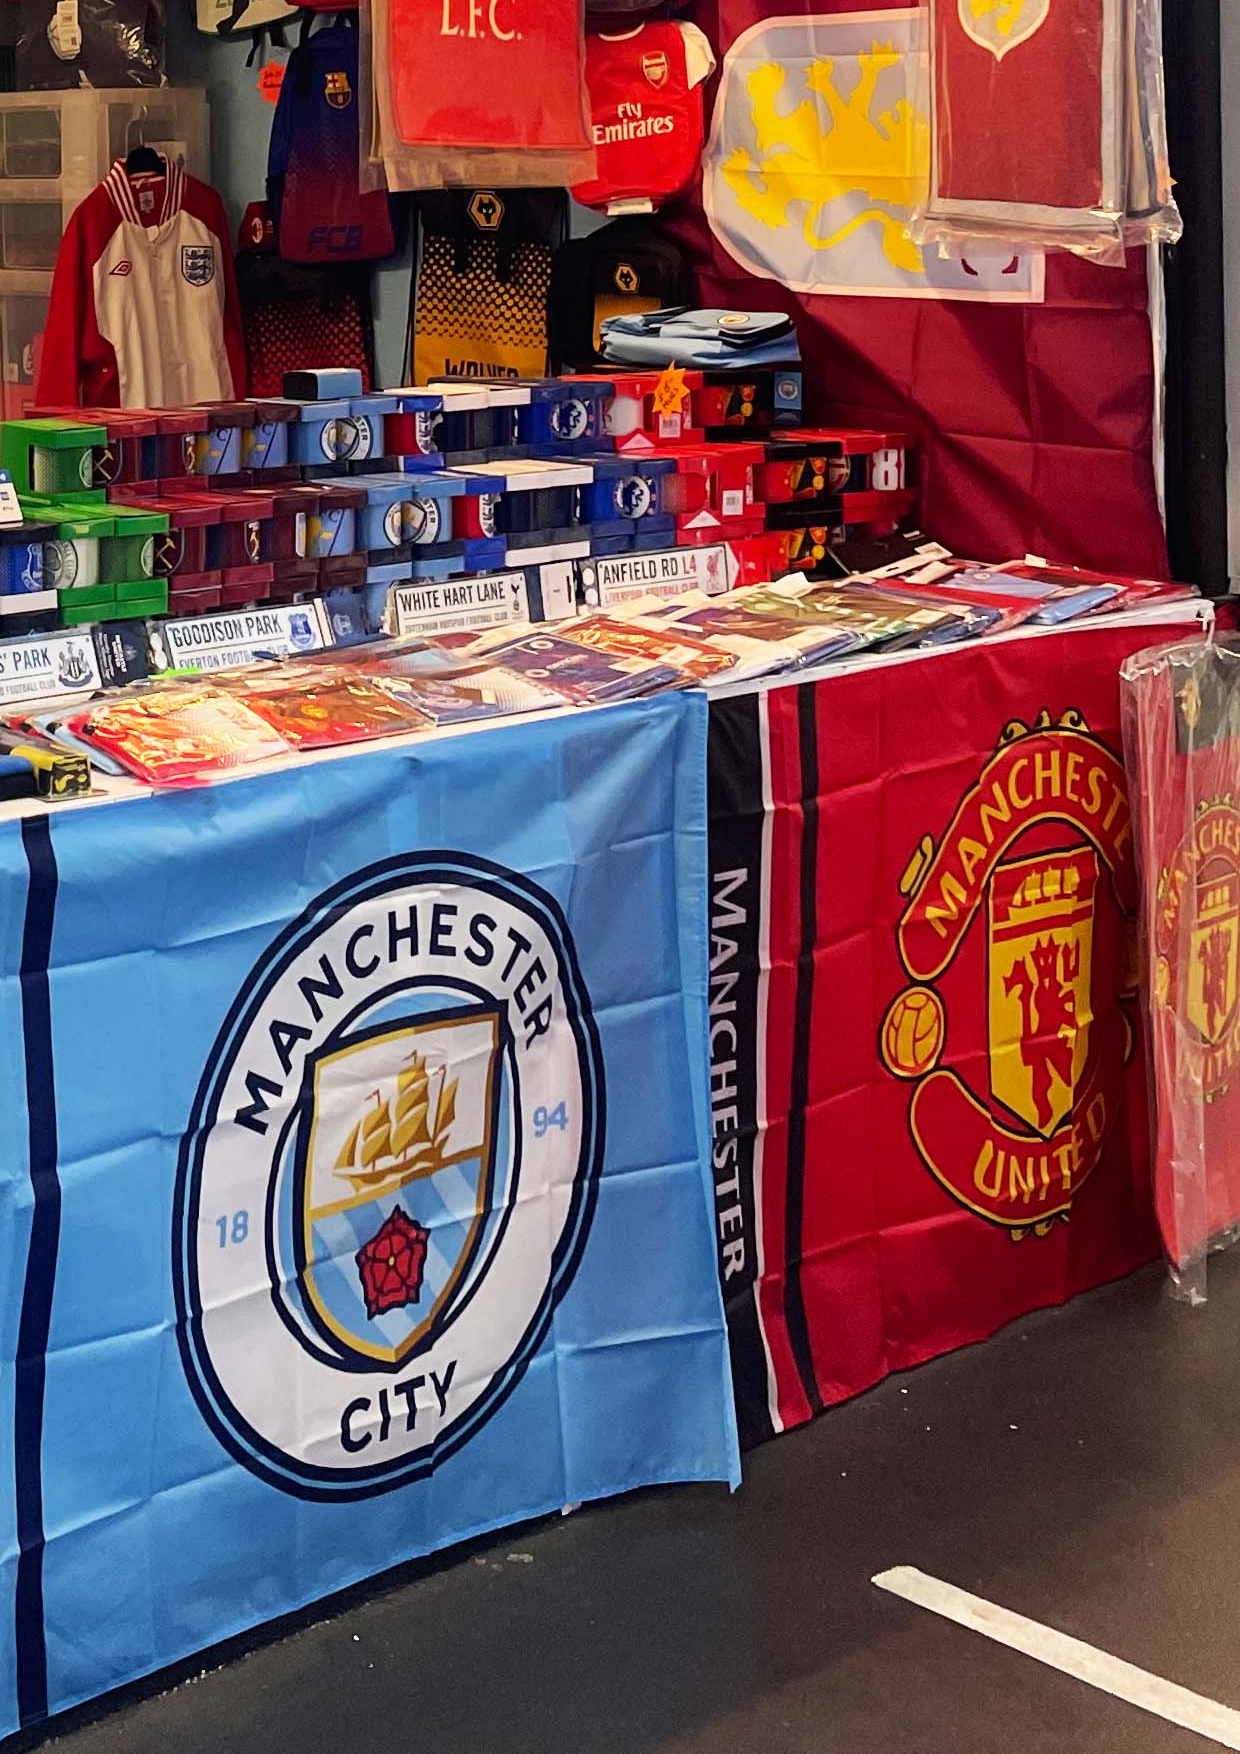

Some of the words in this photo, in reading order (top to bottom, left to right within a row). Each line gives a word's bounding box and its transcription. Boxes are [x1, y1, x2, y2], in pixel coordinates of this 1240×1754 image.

[617, 102, 642, 119] Fly
[591, 115, 675, 146] Emirates
[603, 560, 657, 585] ANFIELD
[661, 557, 679, 577] RD
[682, 554, 697, 575] L4
[400, 590, 441, 613] WHITE
[443, 584, 475, 607] HART
[476, 581, 506, 602] LANE
[172, 617, 243, 648] GOODISON
[245, 613, 284, 638] PARK
[12, 646, 52, 671] PARK
[179, 652, 220, 670] EVERTON
[221, 649, 254, 668] FOOTB
[6, 681, 38, 697] FOOTBALL
[40, 679, 56, 691] CLUB
[924, 749, 1132, 941] MANCHESTE
[234, 902, 556, 1137] MANCHESTER
[708, 866, 750, 1283] MANCHESTER
[530, 1099, 570, 1138] 94
[972, 1091, 1108, 1202] UNITED
[215, 1209, 251, 1249] 18
[339, 1359, 459, 1453] CITY
